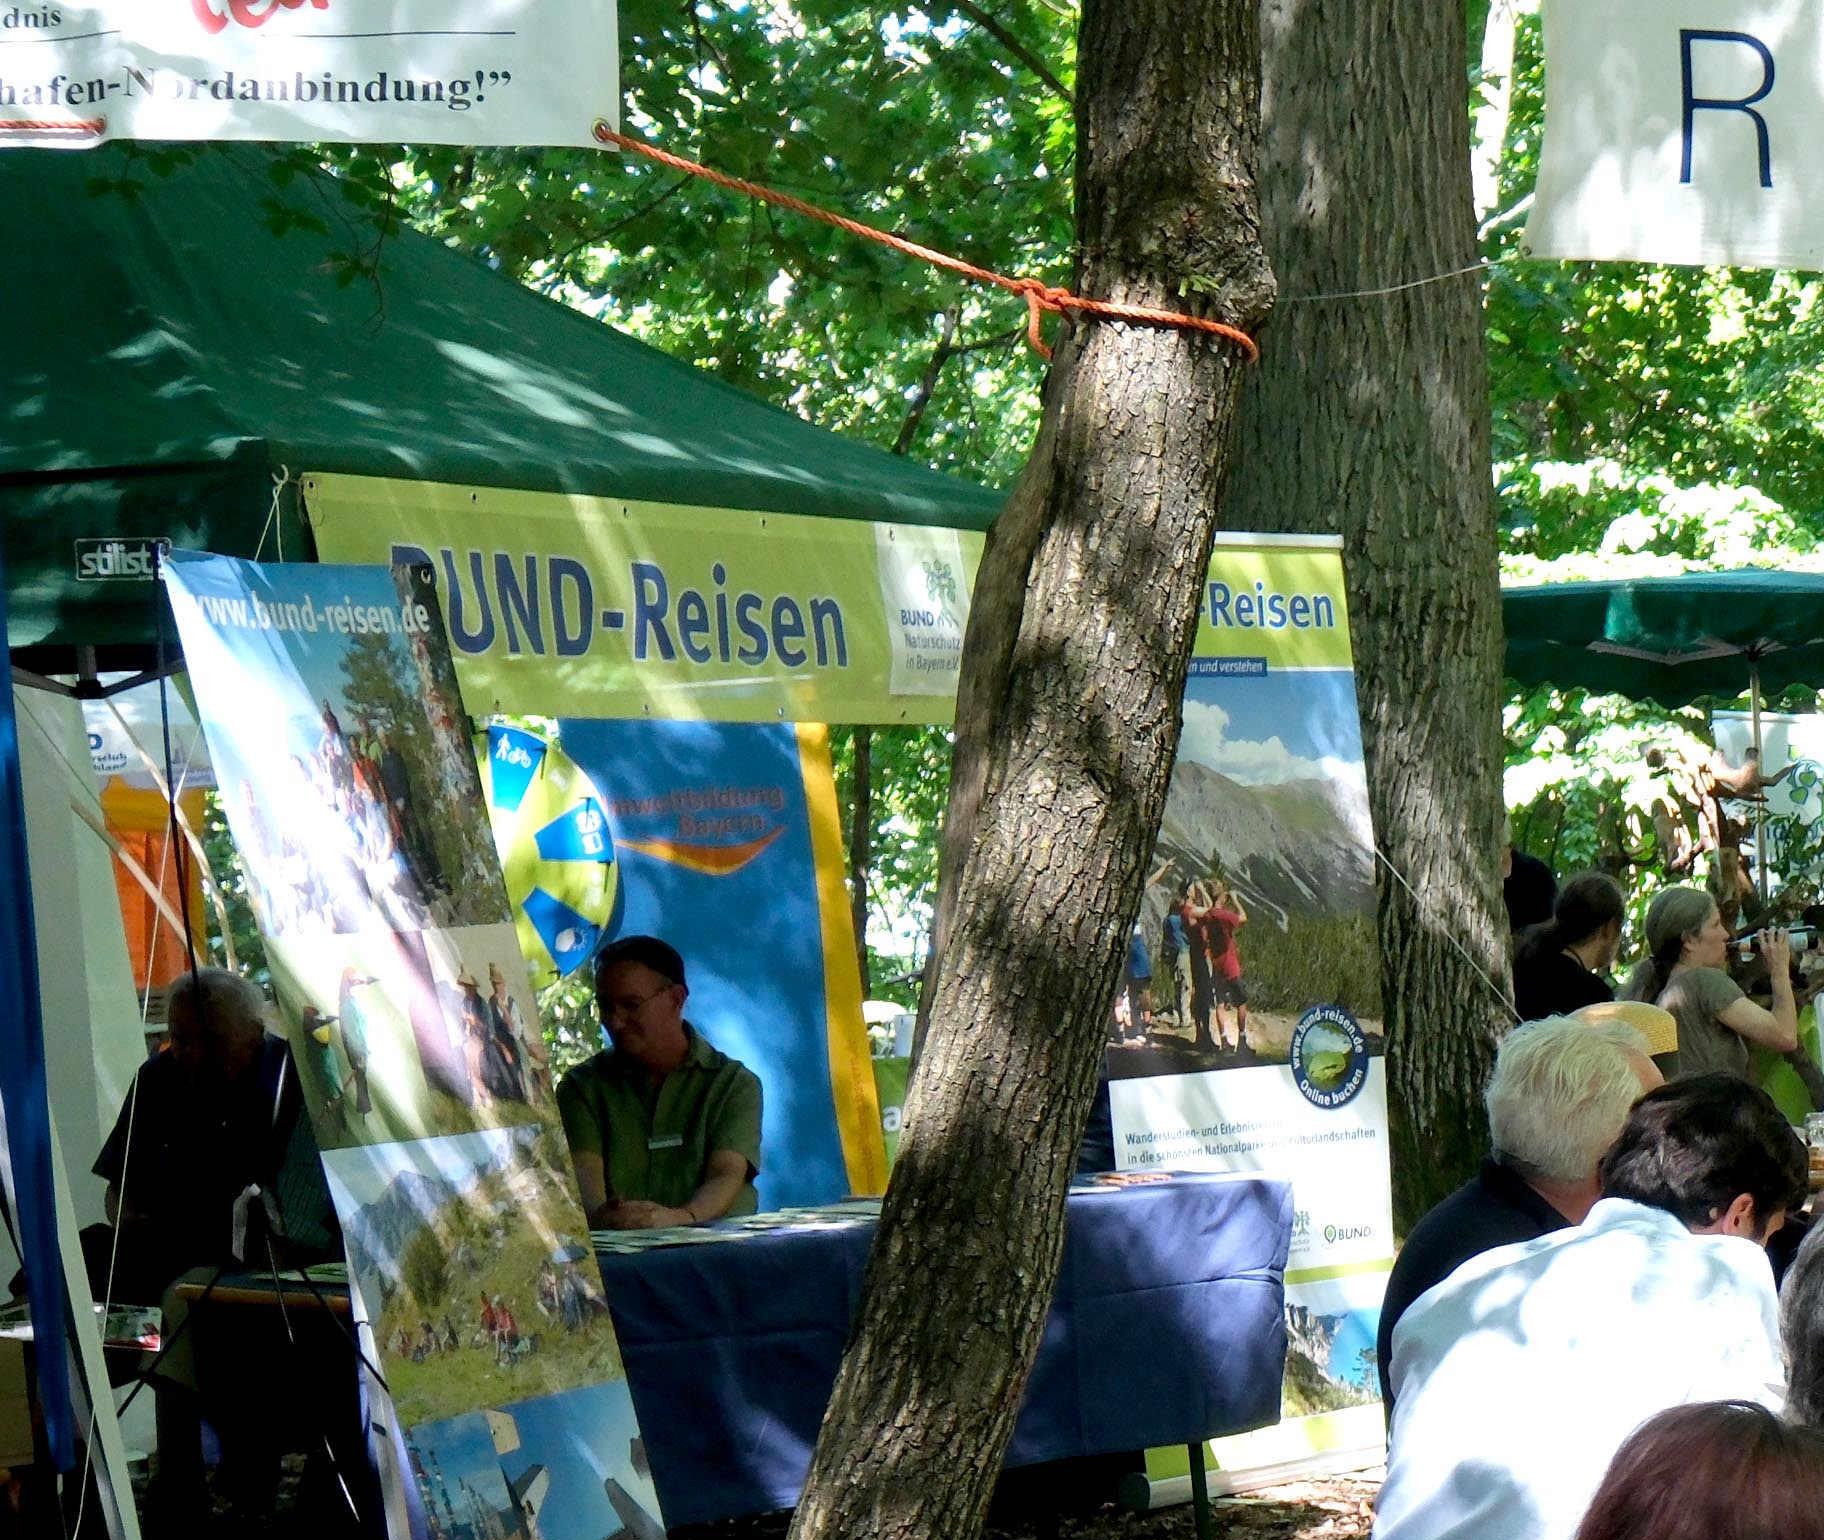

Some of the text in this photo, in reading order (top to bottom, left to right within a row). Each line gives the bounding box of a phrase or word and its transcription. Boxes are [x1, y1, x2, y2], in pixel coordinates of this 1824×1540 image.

[901, 609, 934, 627] BUND
[1199, 661, 1217, 674] und
[1301, 1069, 1364, 1106] Online buchen
[1201, 1124, 1219, 1137] und
[1139, 1151, 1155, 1164] die
